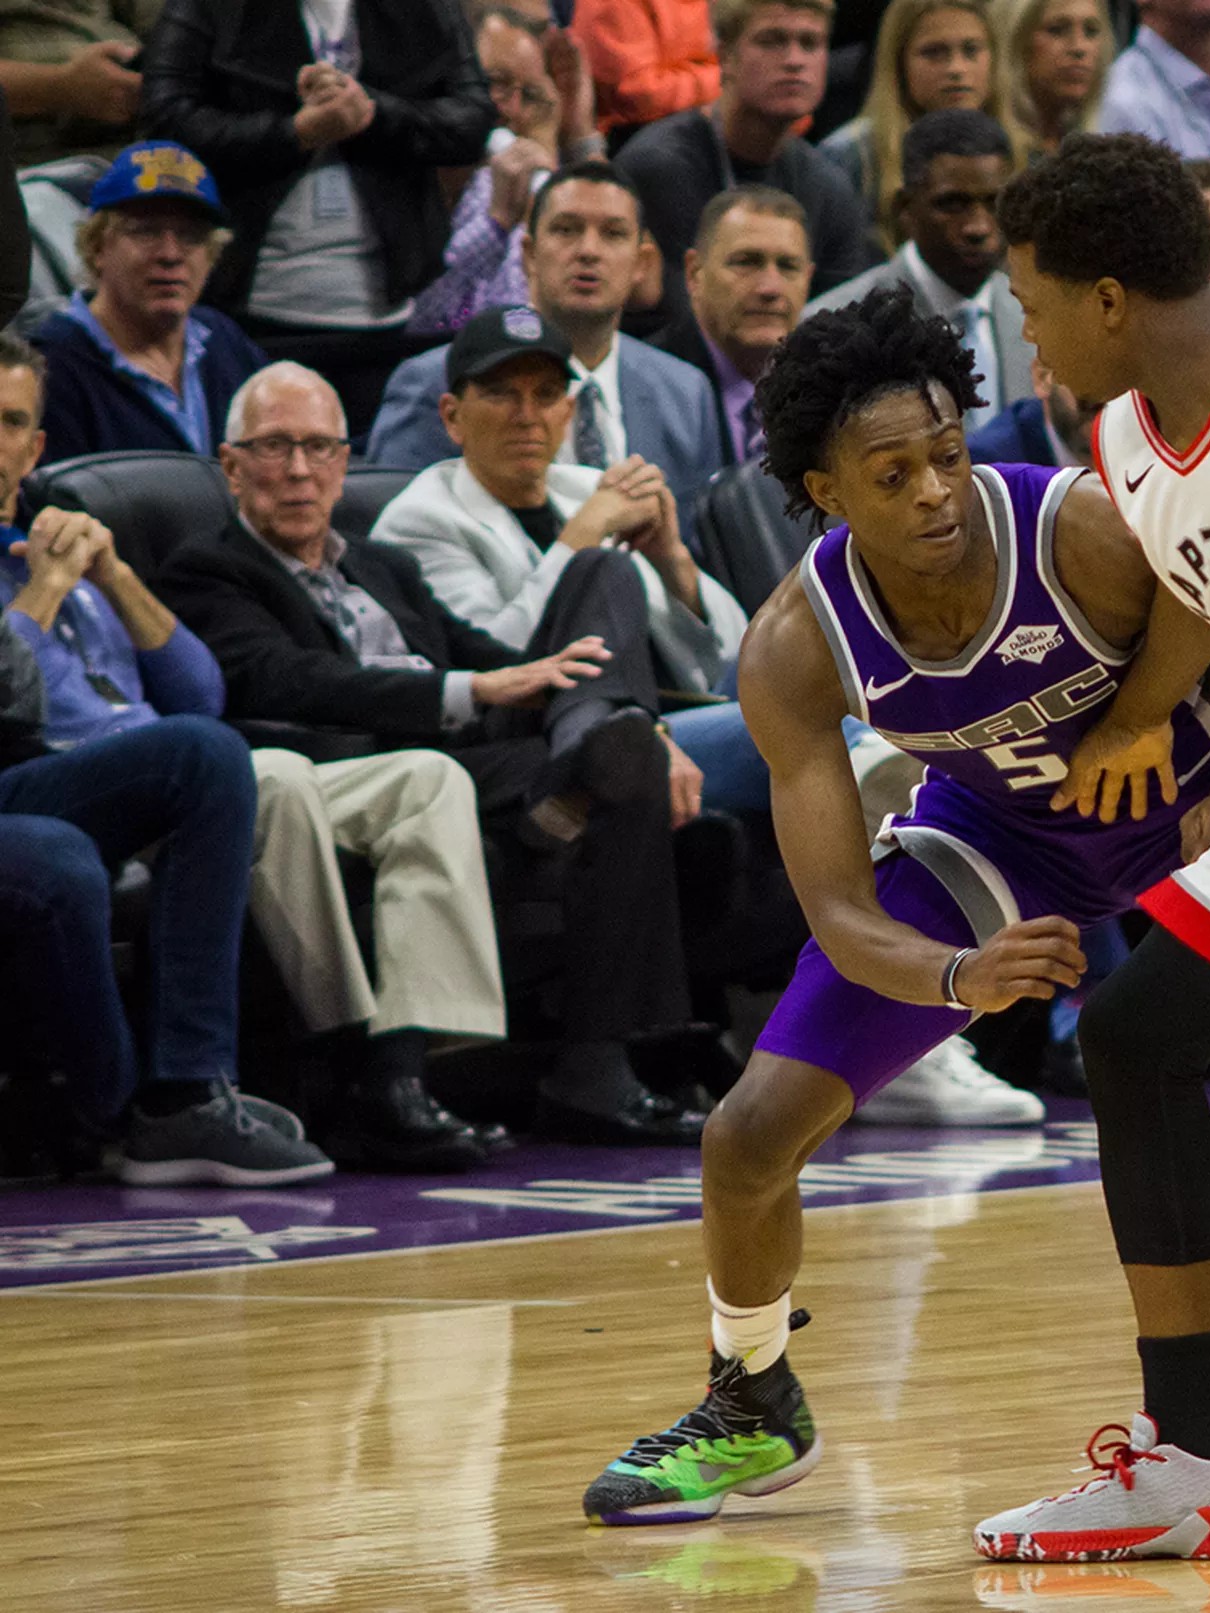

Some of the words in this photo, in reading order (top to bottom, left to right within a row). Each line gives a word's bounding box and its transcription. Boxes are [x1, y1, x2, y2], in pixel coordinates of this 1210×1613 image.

[1003, 637, 1062, 662] ALMONDS
[873, 663, 1118, 751] SAC
[981, 735, 1070, 791] 5
